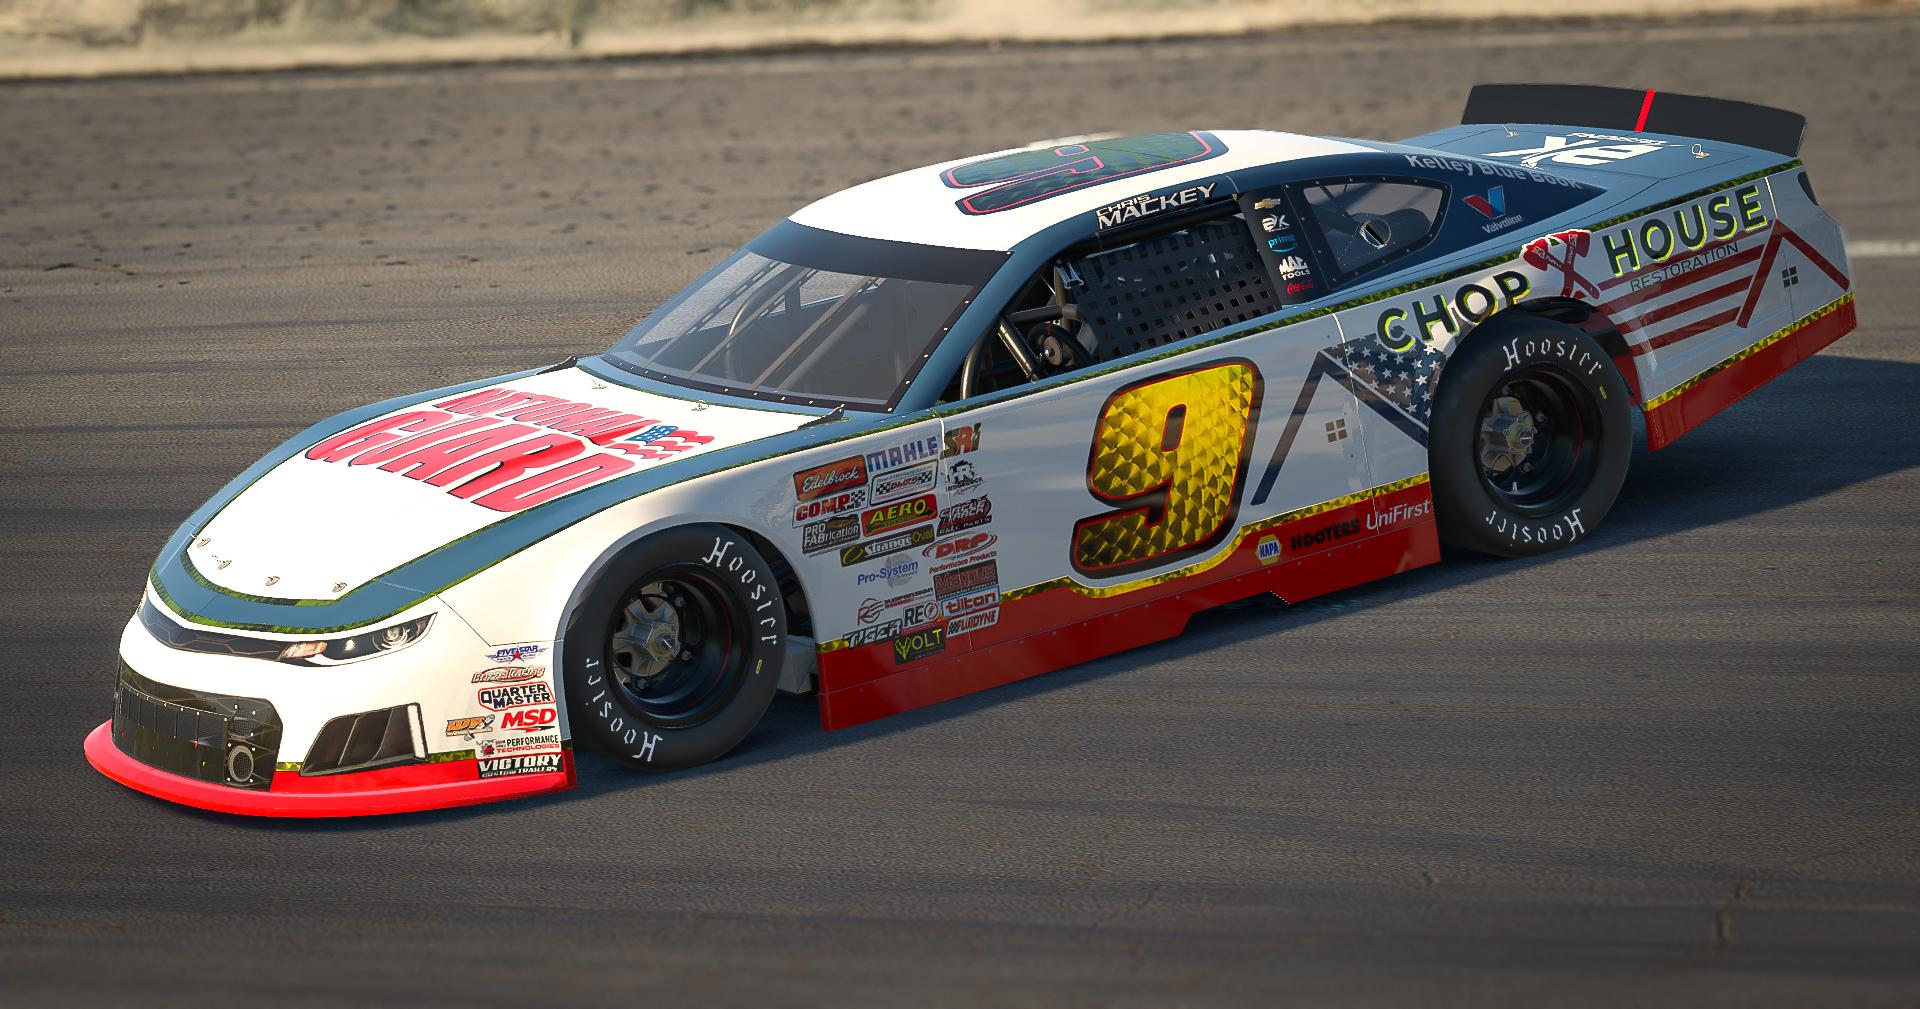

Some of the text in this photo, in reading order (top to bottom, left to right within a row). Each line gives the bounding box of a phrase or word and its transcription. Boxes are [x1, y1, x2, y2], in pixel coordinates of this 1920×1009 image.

[1405, 154, 1584, 190] Kelley Blue Book
[1096, 194, 1151, 217] CHRIS
[1099, 183, 1218, 229] MACKEY
[1482, 213, 1522, 235] Valvoline
[1602, 185, 1768, 278] HOUSE
[1268, 234, 1296, 248] prime
[1279, 256, 1308, 274] MAC
[1282, 270, 1310, 280] TOOLS
[1630, 242, 1739, 292] RESTORATION
[1376, 269, 1532, 354] CHOP
[1503, 337, 1602, 375] Hoosier
[432, 387, 662, 446] NATIONAL
[304, 410, 636, 513] GUARD
[866, 436, 938, 473] MAHLE
[1070, 357, 1264, 578] 9
[802, 465, 860, 493] Edelbrock
[796, 494, 851, 522] COMP
[869, 498, 927, 525] AERO
[1365, 499, 1431, 531] UniFirst
[804, 525, 859, 548] FABrication
[805, 523, 825, 536] PRO
[1290, 519, 1361, 551] HOOTERS
[1485, 508, 1585, 547] Hoosier
[864, 534, 912, 557] Strange
[911, 528, 934, 543] Oval
[935, 531, 989, 559] DRP
[1258, 541, 1280, 559] NAPA
[970, 551, 997, 565] Products
[857, 561, 918, 585] Pro-System
[702, 537, 777, 645] Hoosier
[945, 592, 996, 614] tilton
[957, 609, 997, 633] FLUIDYNE
[894, 628, 943, 660] VOLT
[480, 684, 547, 704] QUARTER
[494, 692, 551, 710] MASTER
[501, 708, 557, 729] MSD
[585, 658, 663, 762] Hoosier
[497, 744, 559, 753] TECHNOLOGIES
[506, 735, 559, 746] PERFORMANCE
[478, 754, 562, 772] VICTORY
